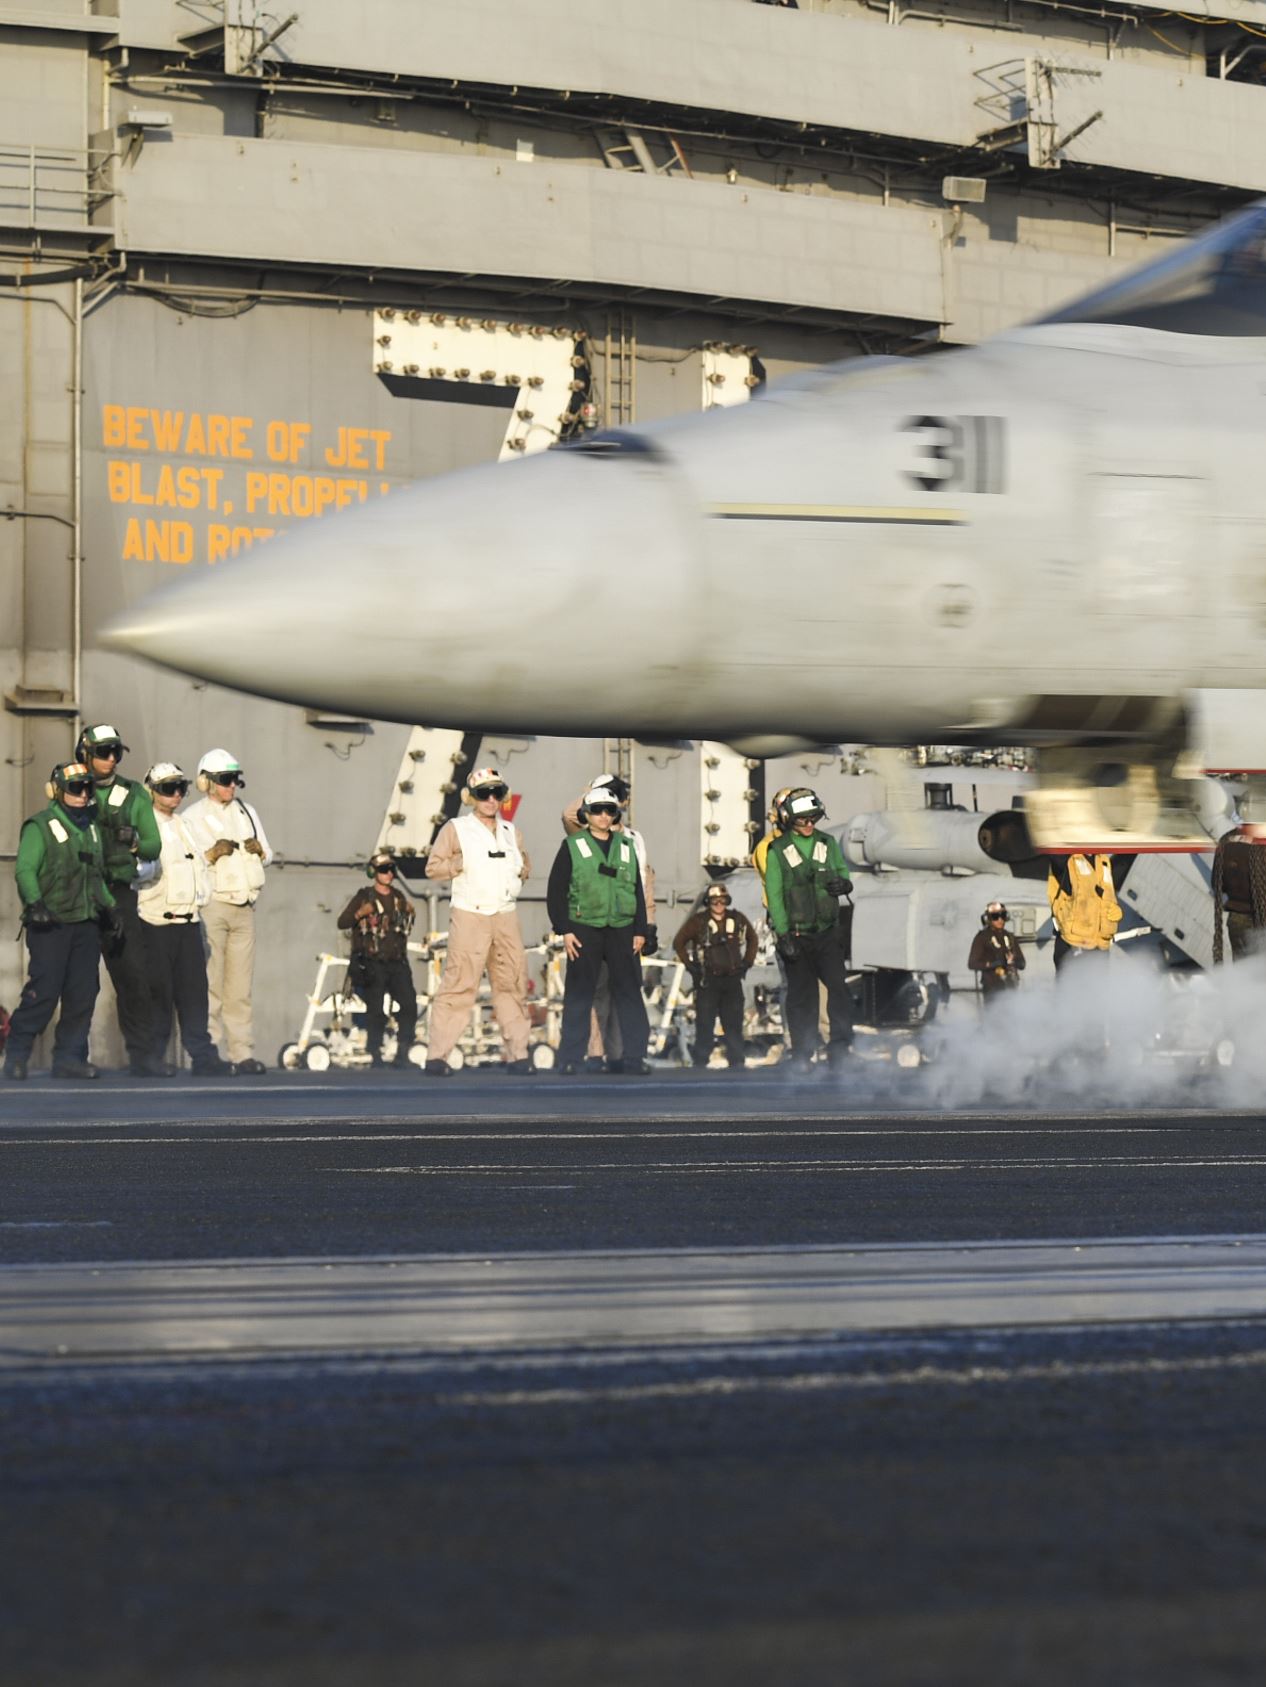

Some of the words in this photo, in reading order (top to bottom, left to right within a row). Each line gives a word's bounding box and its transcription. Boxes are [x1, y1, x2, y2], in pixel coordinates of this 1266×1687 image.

[103, 405, 254, 460] BEWARE
[266, 420, 312, 464] OF
[325, 427, 392, 470] JET
[897, 415, 1007, 494] 311
[107, 461, 233, 517] BLAST,
[246, 471, 390, 518] PROPE
[122, 517, 194, 564] AND
